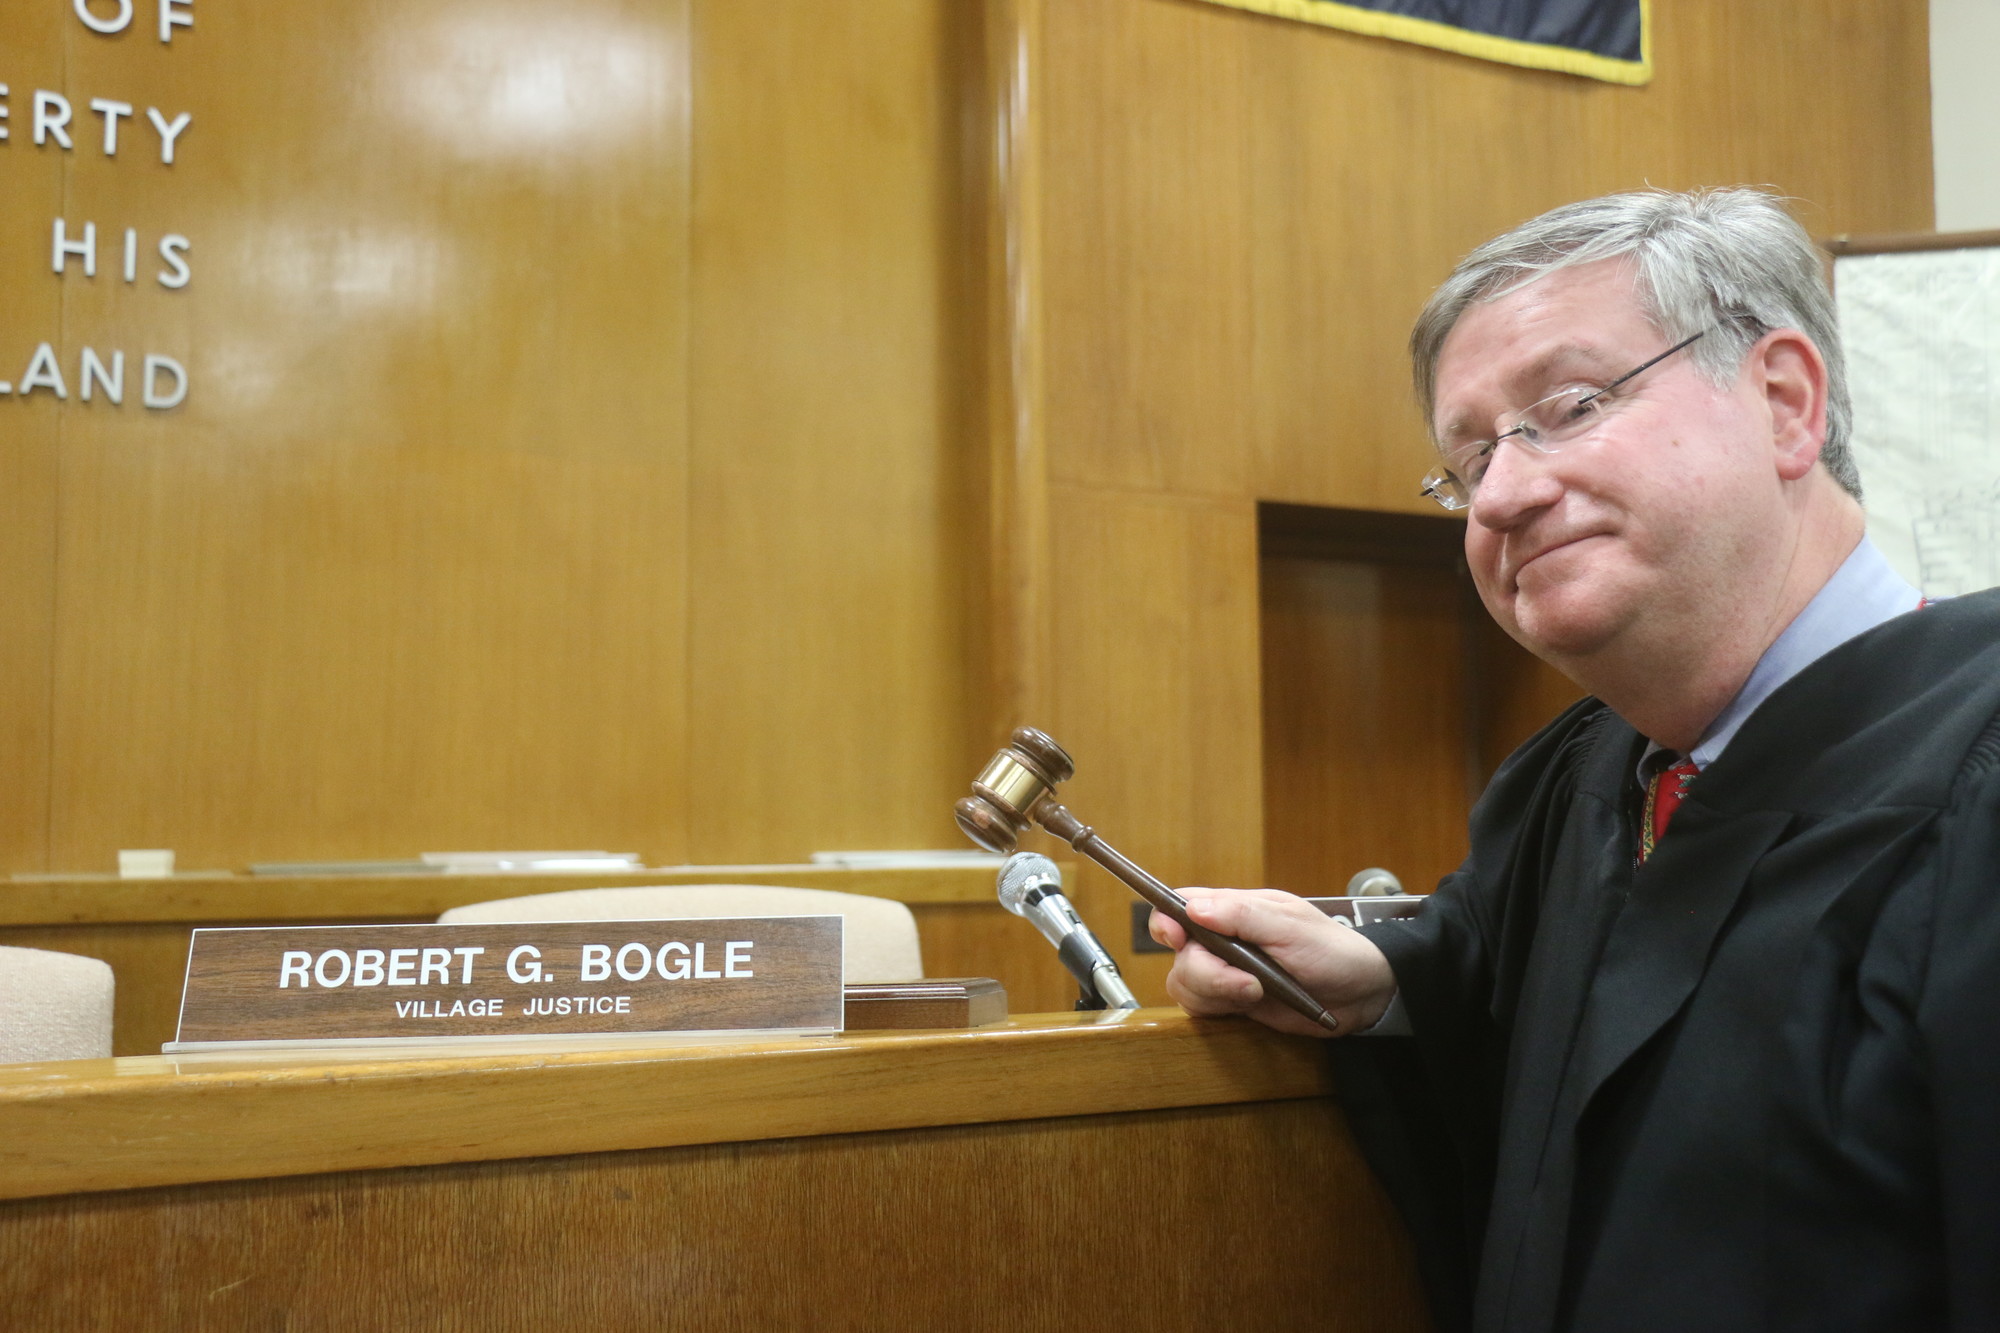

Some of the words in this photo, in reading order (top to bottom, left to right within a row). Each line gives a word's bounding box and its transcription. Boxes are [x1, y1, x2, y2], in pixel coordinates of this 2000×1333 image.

[72, 0, 194, 42] OF
[0, 82, 192, 164] RTY
[51, 217, 192, 289] HIS
[279, 946, 485, 989] ROBERT
[506, 944, 554, 984] G.
[580, 940, 754, 982] BOGLE
[395, 998, 504, 1019] VILLAGE
[522, 996, 632, 1016] JUSTICE
